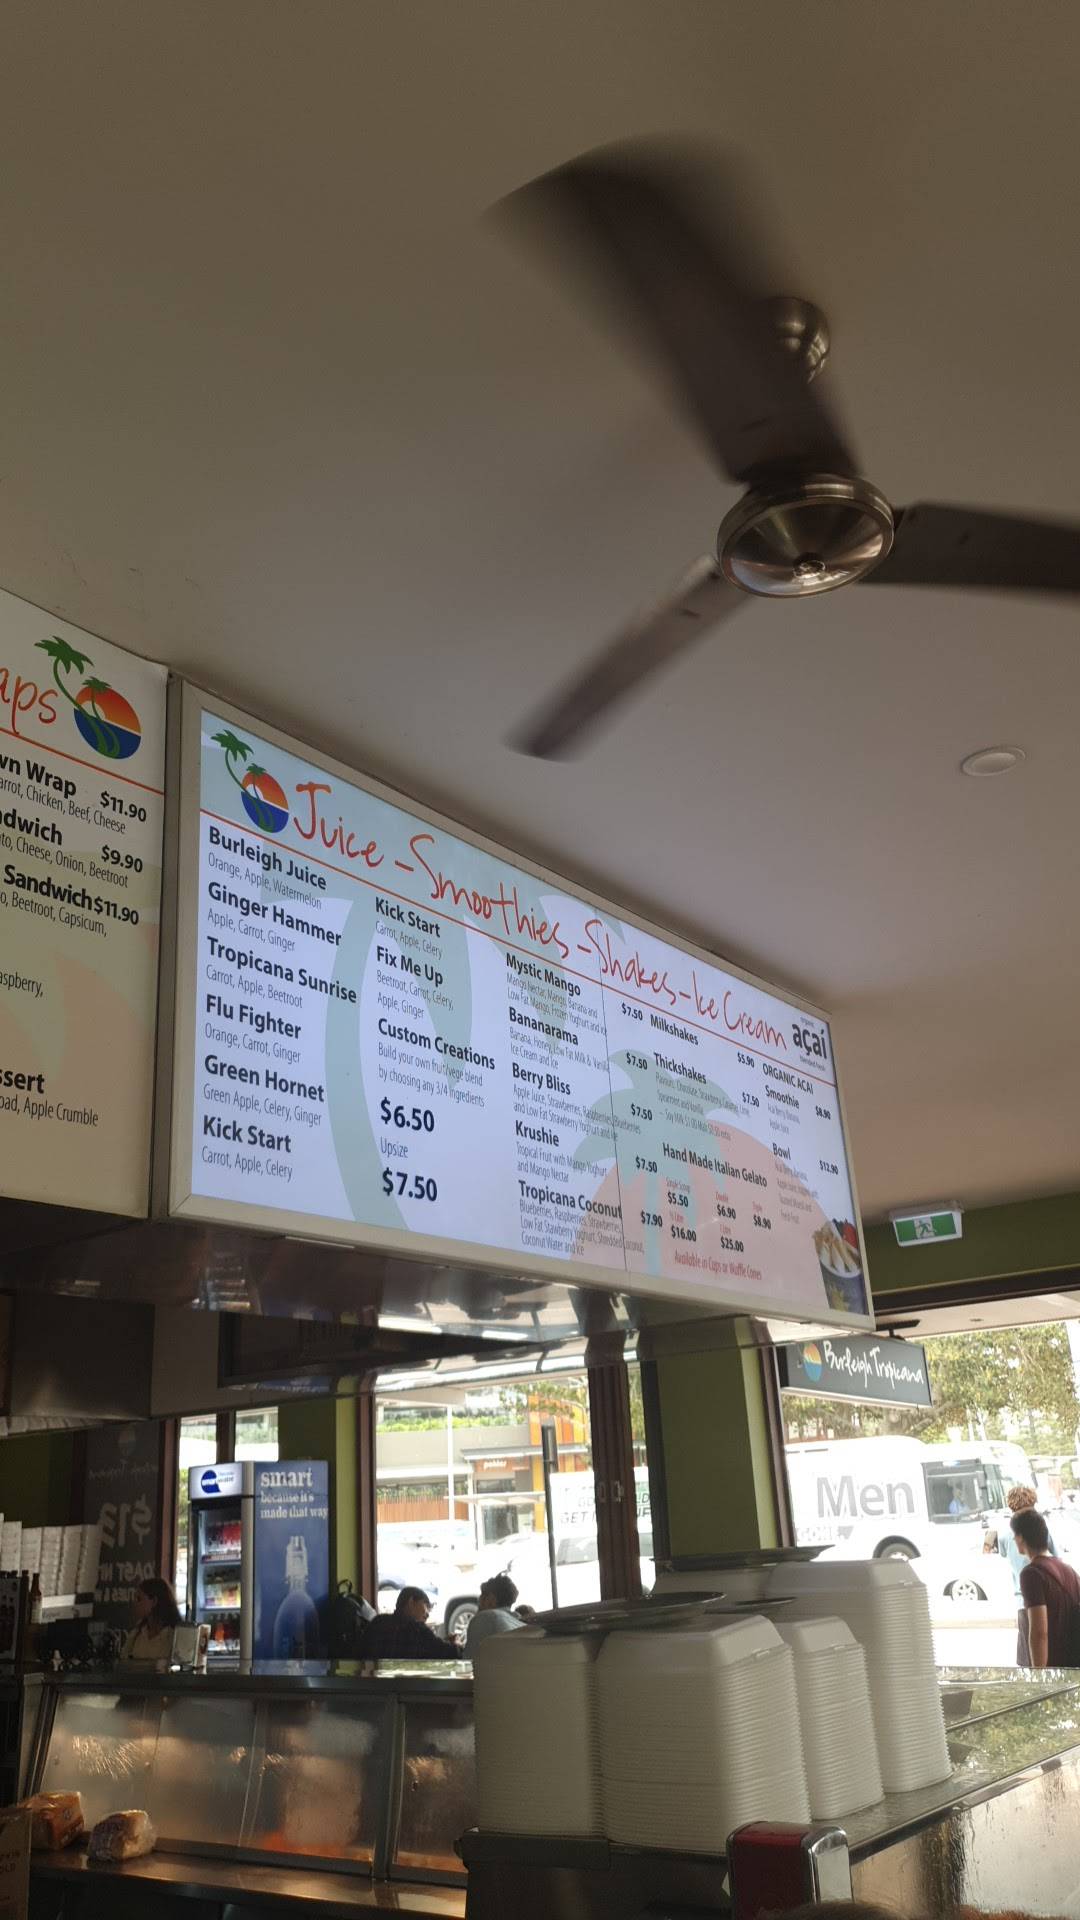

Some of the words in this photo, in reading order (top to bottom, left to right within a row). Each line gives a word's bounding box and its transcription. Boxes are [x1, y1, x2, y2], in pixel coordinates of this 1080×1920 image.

[26, 760, 76, 798] Wrap
[26, 784, 66, 814] Chicken,
[68, 800, 91, 824] Beef,
[93, 810, 126, 834] Cheese
[100, 791, 147, 822] $11.90
[16, 836, 53, 864] Cheese,
[56, 850, 87, 877] Onion,
[89, 861, 128, 888] Beetroot
[101, 845, 143, 873] $9.90
[209, 825, 282, 872] Burleigh
[286, 860, 327, 890] Juice
[3, 864, 92, 911] Sandwich
[94, 896, 139, 925] $11.90
[208, 852, 242, 880] Orange,
[245, 867, 272, 893] Apple,
[273, 879, 322, 910] Watermelon
[12, 891, 56, 921] Beetroot,
[58, 908, 107, 937] Capsicum,
[207, 908, 236, 931] Apple,
[238, 919, 266, 943] Carrot,
[268, 930, 295, 952] Ginger
[208, 881, 269, 917] Ginger
[273, 905, 342, 946] Hammer
[293, 781, 384, 868] Juice
[409, 833, 569, 959] Smoothies
[584, 919, 676, 1006] Shakes
[723, 991, 787, 1050] Cream
[375, 896, 405, 923] Kick
[408, 911, 441, 938] Start
[375, 920, 397, 942] Carrot,
[399, 931, 421, 952] Apple,
[422, 939, 442, 960] Celery
[206, 935, 294, 982] Tropicana
[298, 968, 357, 1004] Sunrise
[376, 945, 397, 968] Fix
[400, 954, 422, 977] Me
[424, 963, 443, 987] Up
[506, 952, 541, 980] Mystic
[544, 968, 581, 997] Mango
[206, 964, 235, 988] Carrot,
[237, 975, 266, 999] Apple,
[268, 984, 303, 1008] Beetroot
[376, 969, 408, 994] Beetroot,
[409, 981, 431, 1002] Carrot,
[432, 990, 454, 1011] Celery,
[206, 994, 234, 1020] Flu
[239, 1003, 302, 1039] Fighter
[377, 991, 400, 1012] Apple,
[401, 999, 424, 1020] Ginger
[621, 1002, 643, 1020] $7.50
[509, 1006, 579, 1045] Bananarama
[650, 1014, 699, 1045] Milkshakes
[205, 1022, 240, 1049] Orange,
[243, 1033, 271, 1057] Carrot,
[273, 1042, 301, 1065] Ginger
[378, 1017, 431, 1050] Custom
[434, 1036, 496, 1070] Creations
[520, 1047, 537, 1061] Cream
[626, 1052, 647, 1070] $7.50
[737, 1052, 755, 1068] $5.90
[204, 1054, 260, 1086] Green
[265, 1069, 325, 1102] Hornet
[378, 1041, 397, 1060] Build
[398, 1051, 414, 1065] your
[415, 1056, 431, 1070] own
[464, 1070, 483, 1086] blend
[512, 1062, 543, 1089] Berry
[546, 1073, 571, 1095] Bliss
[653, 1052, 707, 1084] Thickshakes
[762, 1063, 796, 1088] ORGANIC
[797, 1080, 814, 1095] ACAI
[378, 1063, 388, 1082] by
[389, 1068, 421, 1092] choosing
[422, 1079, 435, 1096] any
[436, 1081, 448, 1097] 3/4
[449, 1088, 485, 1108] ingredients
[742, 1092, 759, 1107] $7.50
[765, 1085, 800, 1109] Smoothie
[24, 1097, 54, 1120] Apple
[56, 1102, 99, 1127] Crumble
[203, 1083, 231, 1105] Green
[233, 1090, 262, 1113] Apple,
[264, 1097, 292, 1122] Celery,
[294, 1105, 322, 1128] Ginger
[380, 1096, 435, 1132] $6.50
[631, 1104, 653, 1120] $7.50
[815, 1105, 831, 1120] $8.90
[203, 1114, 243, 1143] Kick
[247, 1125, 292, 1153] Start
[380, 1136, 409, 1159] Upsize
[515, 1120, 559, 1147] Krushie
[202, 1146, 232, 1169] Carrot,
[234, 1152, 264, 1176] Apple,
[266, 1158, 293, 1183] Celery
[635, 1156, 657, 1173] $7.50
[662, 1142, 687, 1162] Hand
[689, 1150, 713, 1171] Made
[714, 1158, 740, 1179] Italian
[741, 1167, 768, 1187] Gelato
[772, 1143, 791, 1160] Bowl
[819, 1160, 838, 1175] $12.90
[382, 1167, 438, 1202] $7.50
[517, 1160, 529, 1173] and
[530, 1163, 551, 1179] Mango
[551, 1168, 569, 1183] Nectar
[518, 1179, 576, 1208] Tropicana
[578, 1195, 622, 1219] Coconut
[667, 1191, 689, 1207] $5.50
[717, 1204, 736, 1220] $6.90
[641, 1210, 663, 1227] $7.90
[671, 1224, 697, 1242] $16.00
[753, 1214, 771, 1230] $8.90
[720, 1236, 744, 1252] $25.00
[709, 1257, 721, 1273] Cups
[823, 1340, 872, 1389] Burleigh
[870, 1346, 924, 1390] Tropicana
[260, 1467, 313, 1487] smart
[260, 1490, 299, 1504] because
[260, 1506, 288, 1519] made
[289, 1505, 309, 1518] that
[310, 1507, 329, 1520] way
[816, 1475, 915, 1519] Men
